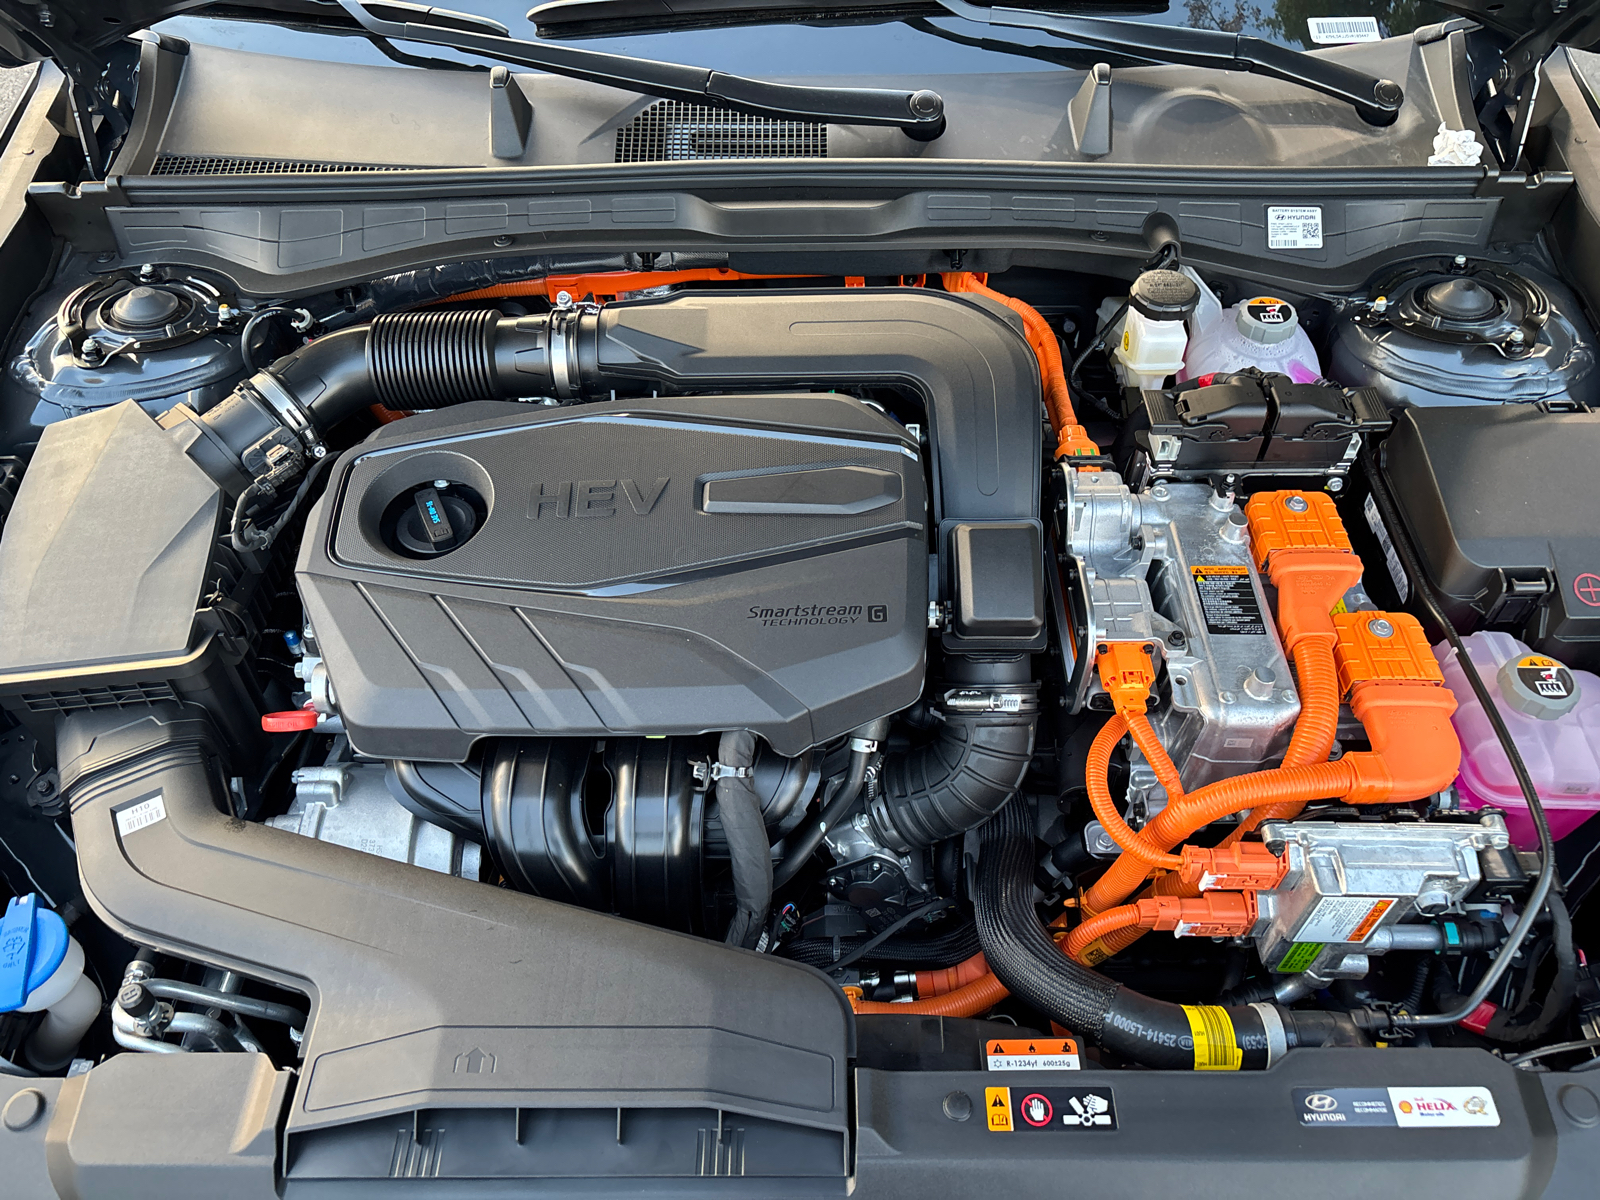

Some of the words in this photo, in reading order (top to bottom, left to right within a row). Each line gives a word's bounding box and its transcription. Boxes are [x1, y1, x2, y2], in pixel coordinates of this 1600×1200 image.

[526, 477, 670, 520] HEV
[747, 605, 862, 618] Smartstream
[762, 616, 860, 627] TECHNOLOGY
[131, 802, 150, 814] H10
[1114, 1014, 1177, 1048] 25414-L5000
[1416, 1102, 1455, 1110] HELIX
[1304, 1112, 1346, 1122] HYUNDAI
